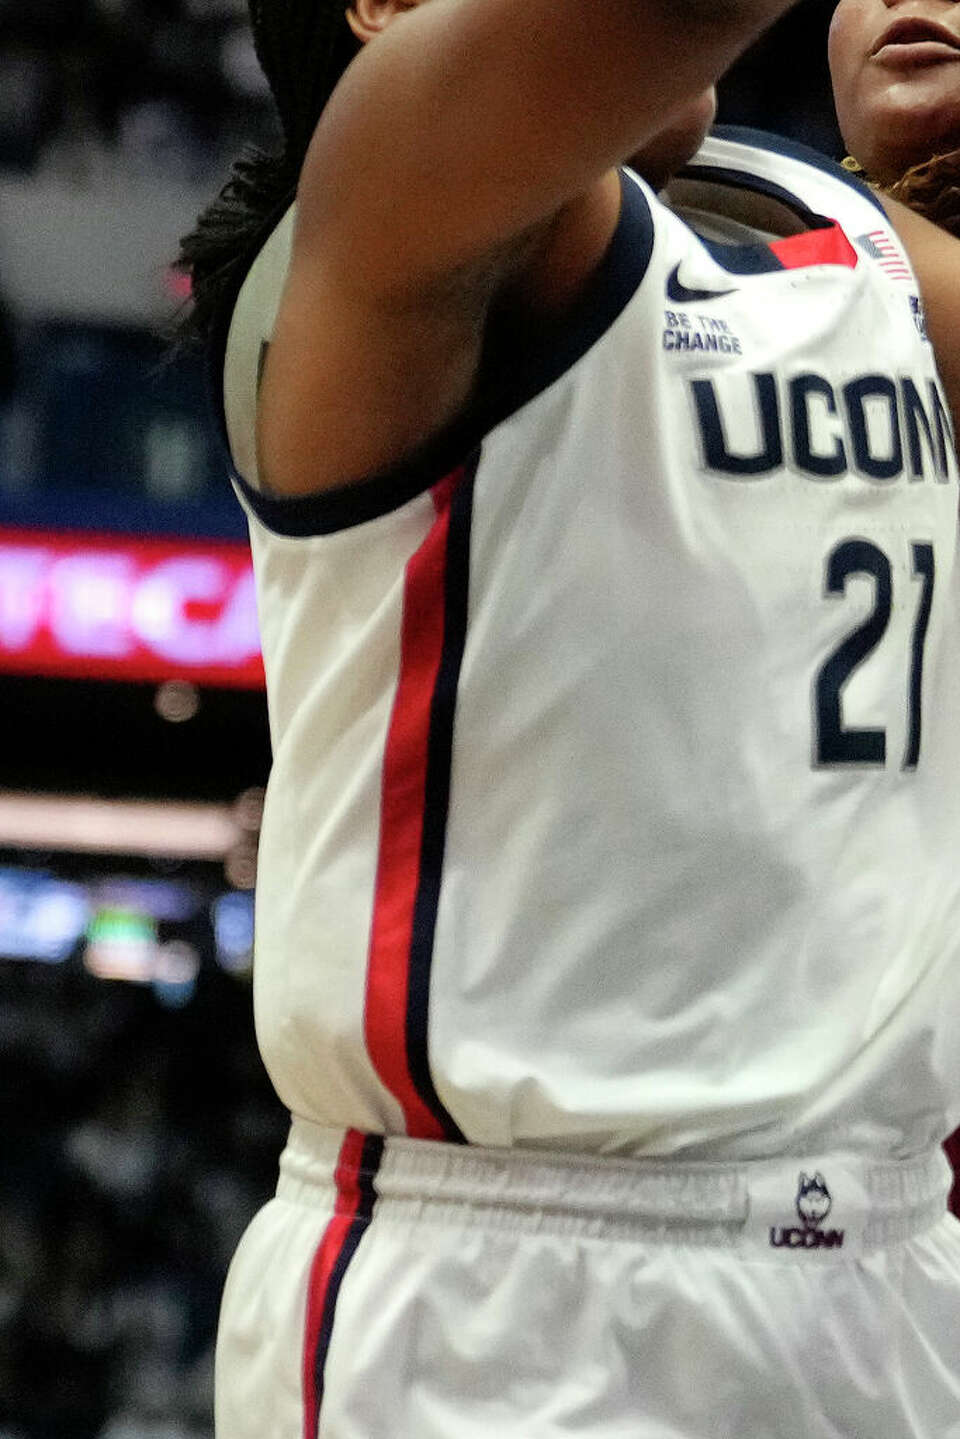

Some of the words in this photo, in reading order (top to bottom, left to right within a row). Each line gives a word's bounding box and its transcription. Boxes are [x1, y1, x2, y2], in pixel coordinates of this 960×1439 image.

[664, 310, 692, 329] BE
[696, 314, 733, 336] THE
[662, 328, 743, 356] CHANGE
[811, 535, 935, 771] 21
